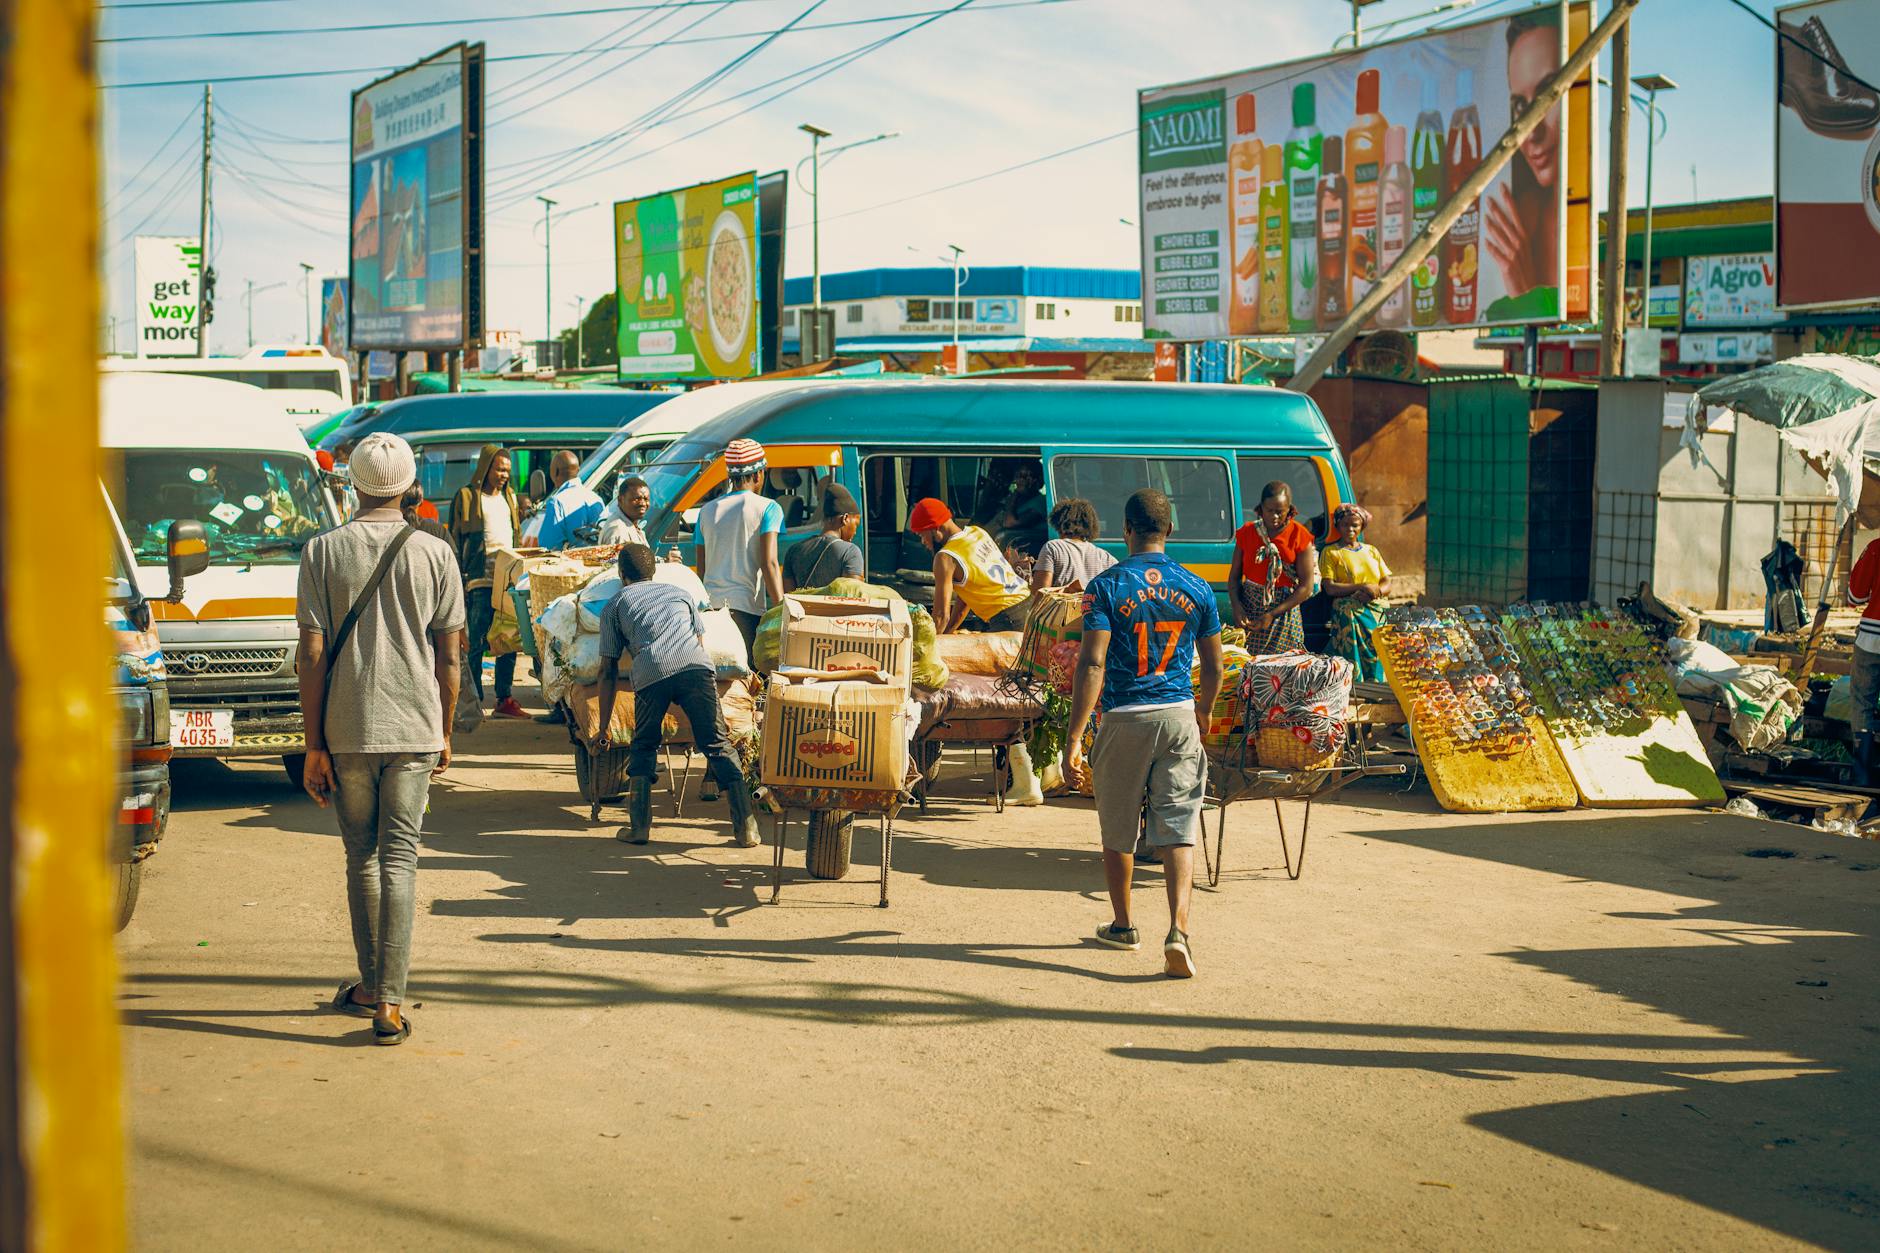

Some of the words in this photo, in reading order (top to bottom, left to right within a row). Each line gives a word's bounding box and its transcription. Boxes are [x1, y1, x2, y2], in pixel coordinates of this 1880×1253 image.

[1148, 107, 1222, 150] NAOMI
[1146, 176, 1163, 192] Feel
[1165, 175, 1178, 189] the
[1146, 196, 1183, 212] embrace
[1184, 193, 1199, 207] the
[1161, 234, 1194, 249] SHOWER
[1196, 233, 1211, 246] GEL
[1160, 255, 1191, 271] BUBBLE
[1192, 254, 1213, 268] BATH
[1721, 256, 1764, 266] LUSAKA
[154, 279, 190, 301] get
[1156, 278, 1188, 292] SHOWER
[1189, 276, 1218, 290] CREAM
[148, 302, 196, 324] way
[1165, 298, 1192, 312] SCRUB
[1193, 298, 1208, 312] GEL
[144, 326, 200, 340] more
[1119, 598, 1138, 618] DE
[1137, 586, 1196, 615] BRUYNE
[1133, 621, 1187, 677] 17
[186, 711, 213, 727] ABR
[180, 729, 216, 745] 4035
